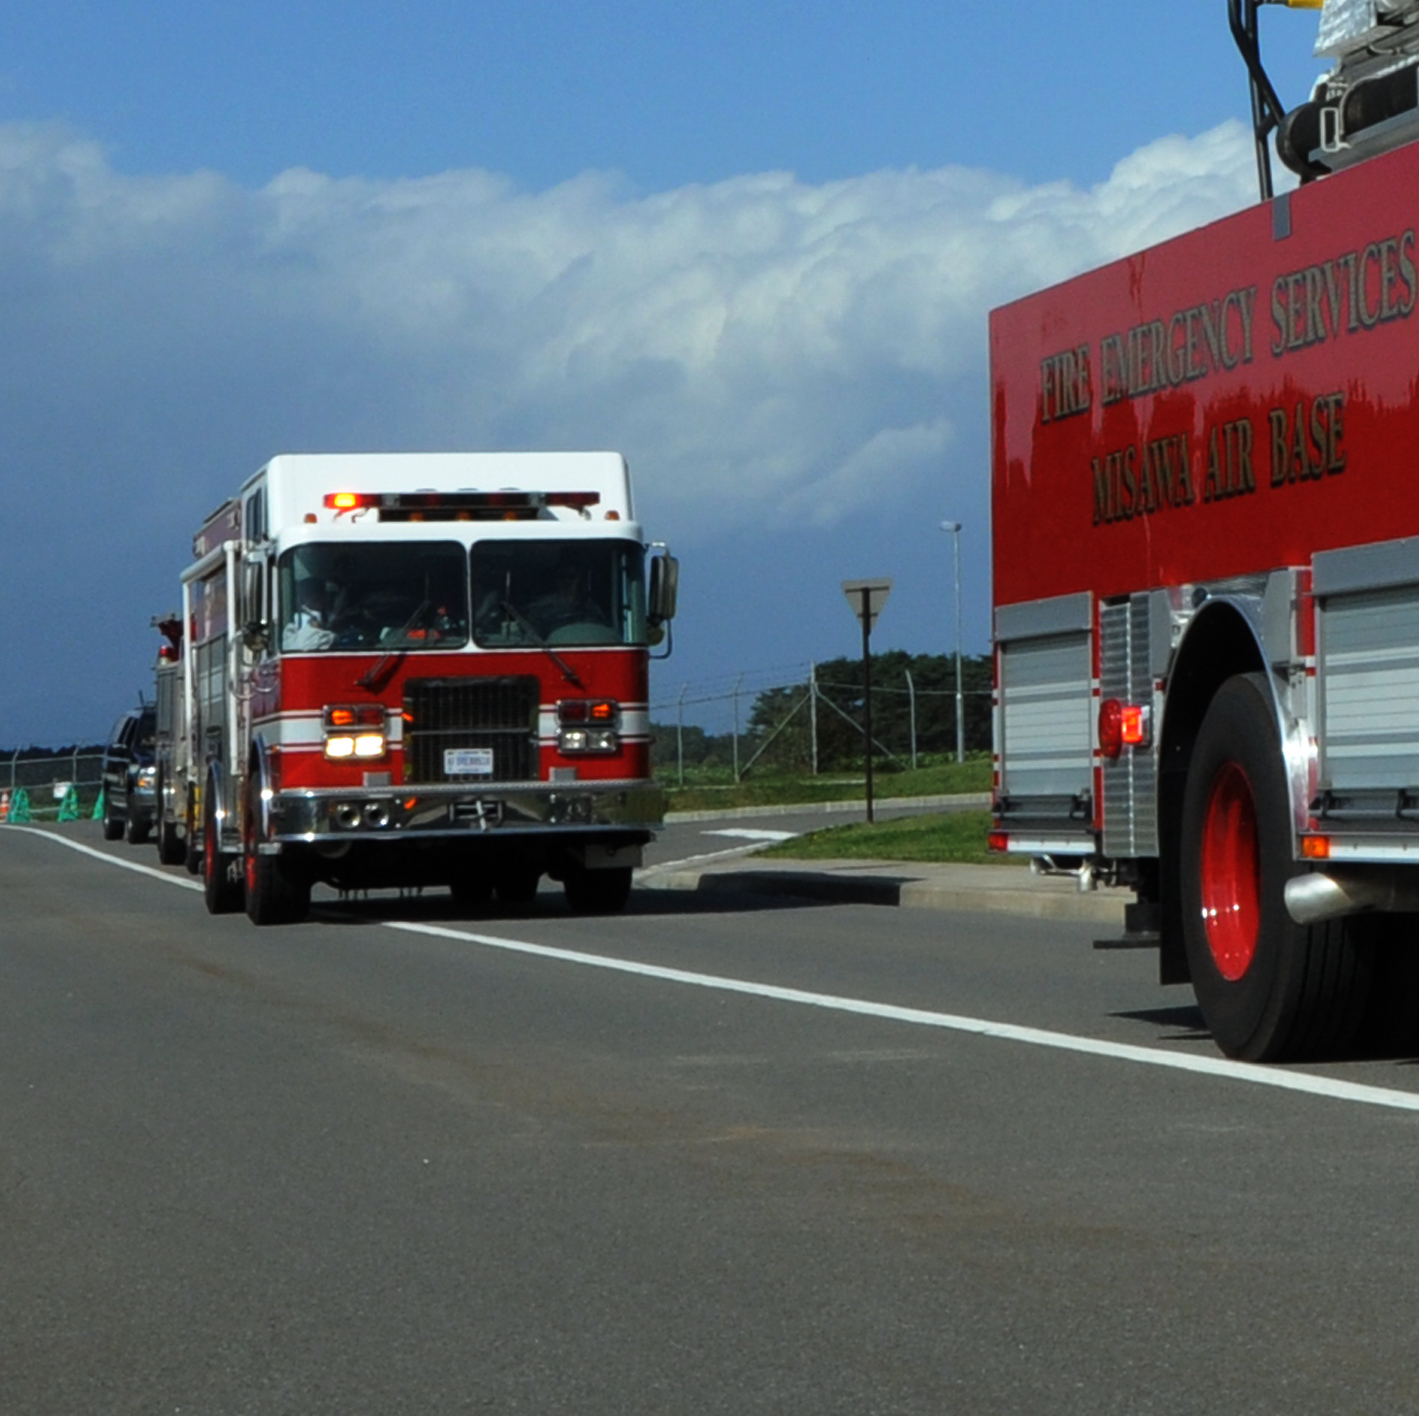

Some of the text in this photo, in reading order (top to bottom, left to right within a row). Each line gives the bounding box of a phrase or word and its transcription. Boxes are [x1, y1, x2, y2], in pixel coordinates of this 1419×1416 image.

[1041, 229, 1418, 425] FIRE EMERGENCY SERVICES
[1092, 392, 1348, 525] MISAWA AIR BASE
